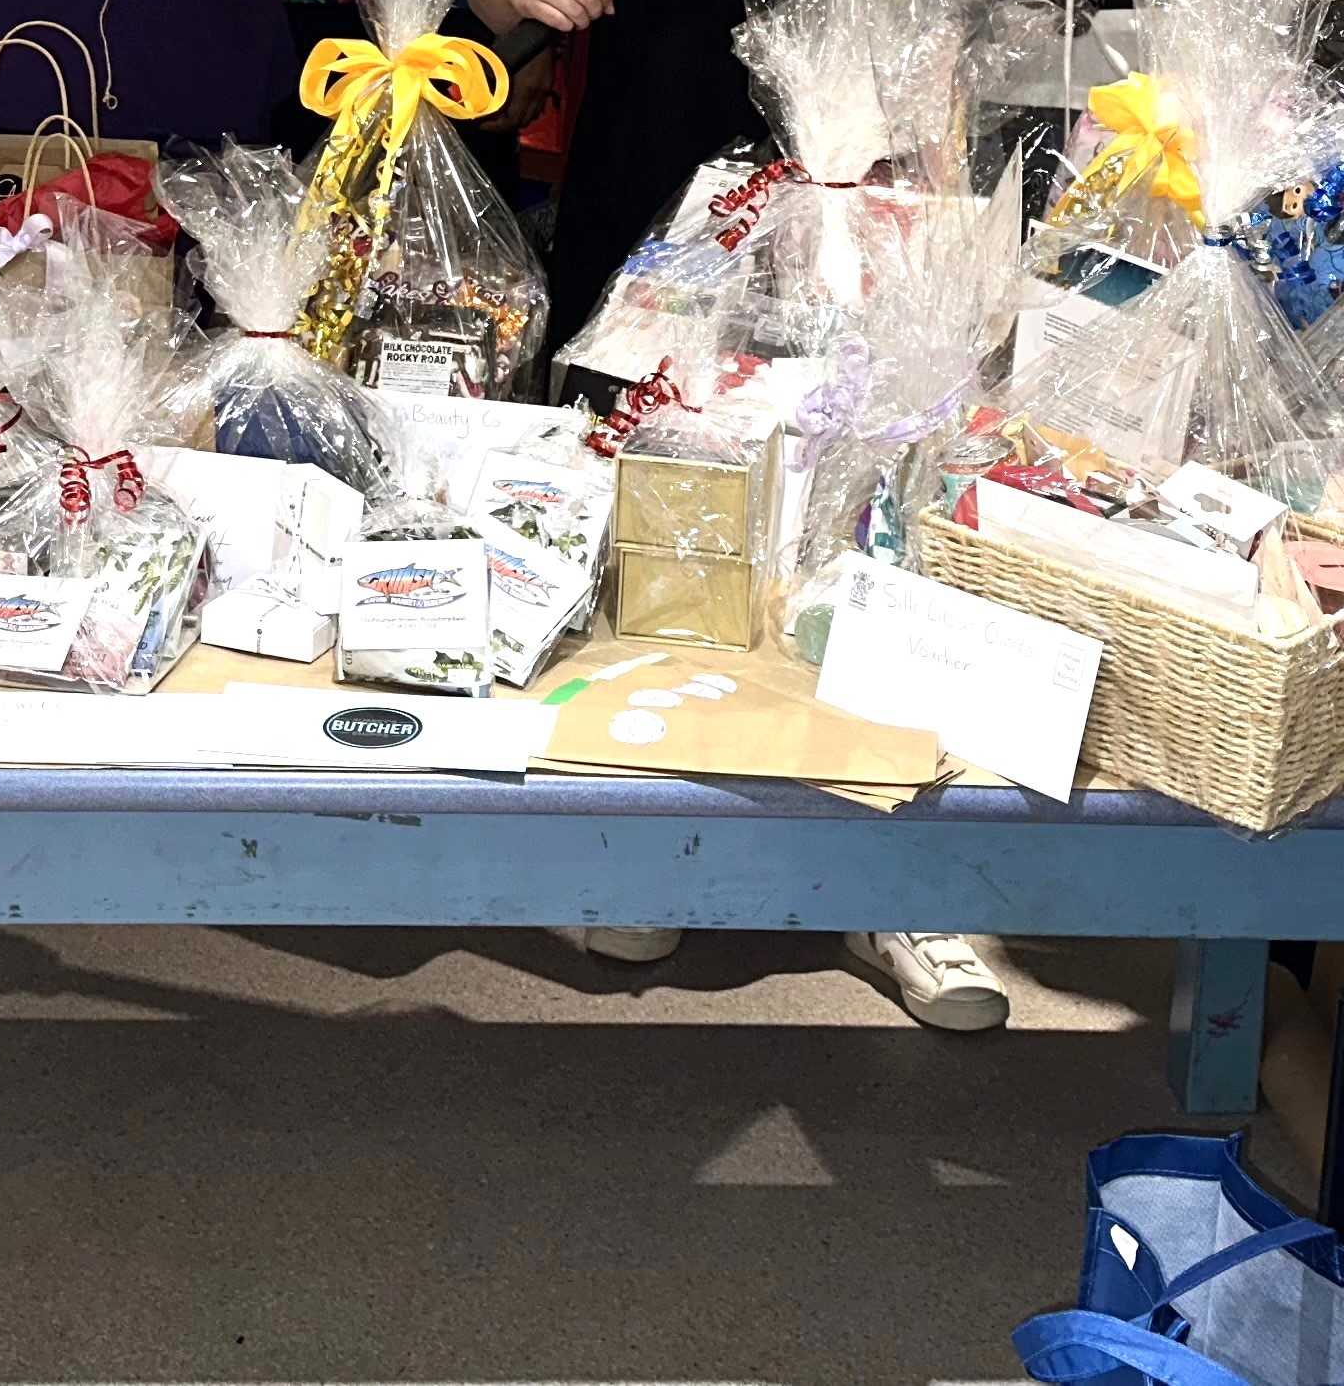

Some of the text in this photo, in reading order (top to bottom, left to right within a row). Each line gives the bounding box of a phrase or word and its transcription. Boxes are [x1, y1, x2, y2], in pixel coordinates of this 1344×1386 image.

[383, 342, 452, 355] MILK CHOCOLATE
[386, 353, 447, 365] ROCKY ROAD
[412, 403, 501, 440] Beauty Co
[330, 719, 414, 735] BUTCHER
